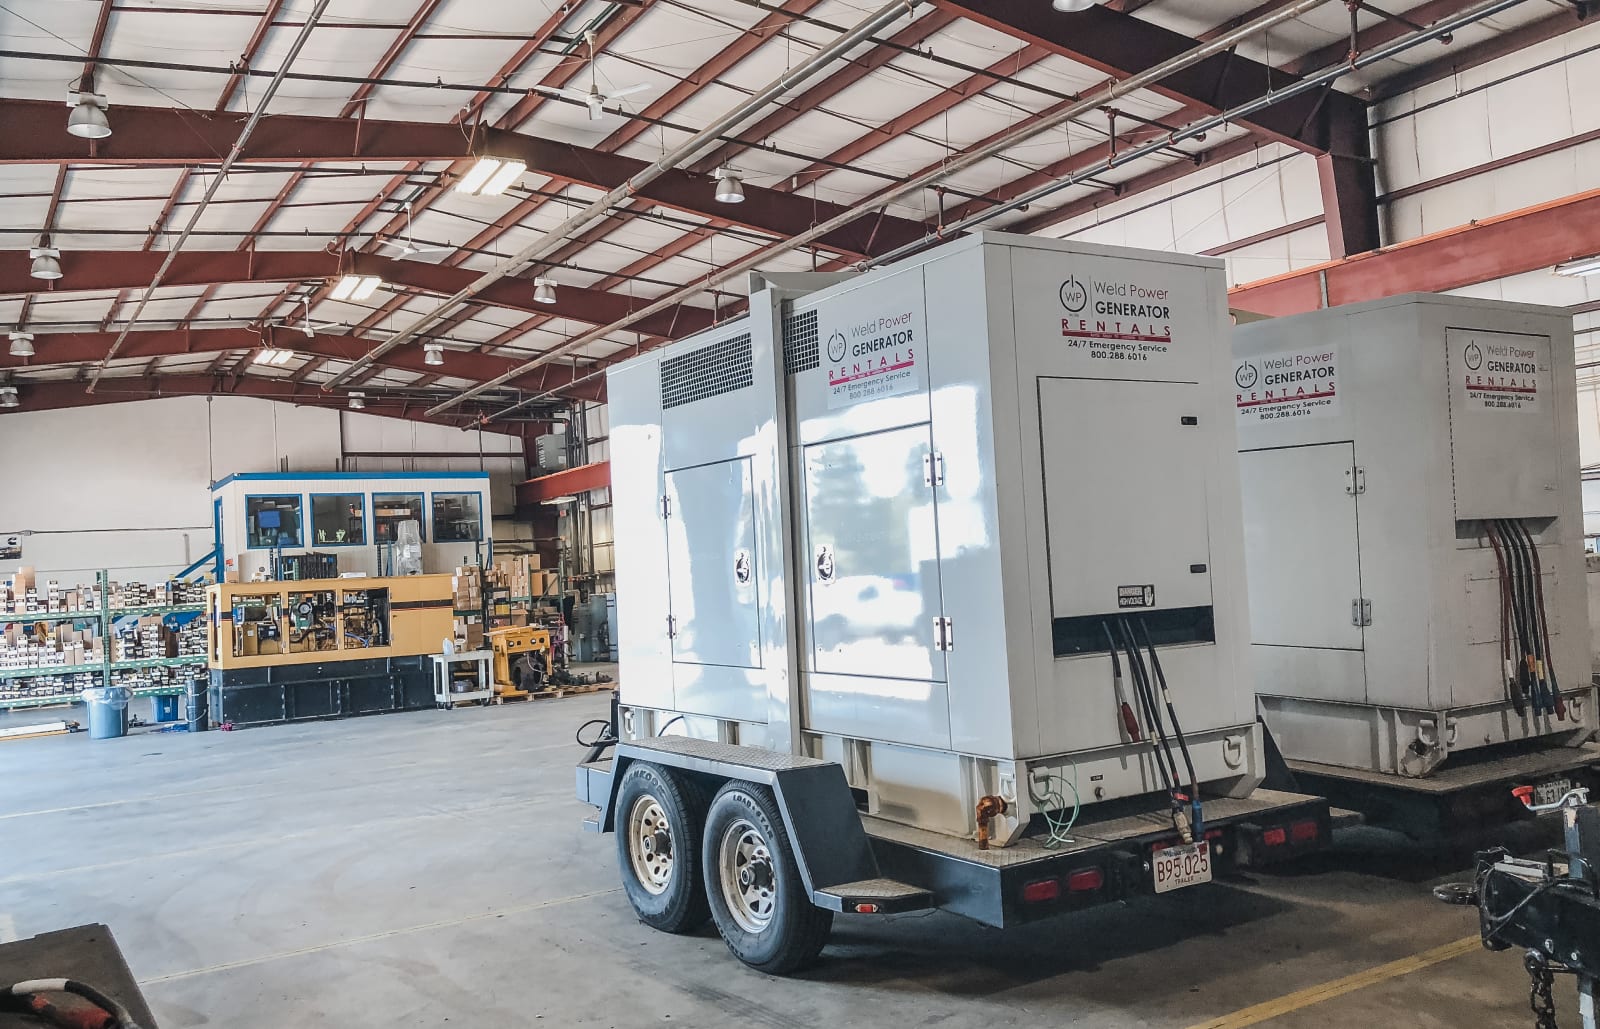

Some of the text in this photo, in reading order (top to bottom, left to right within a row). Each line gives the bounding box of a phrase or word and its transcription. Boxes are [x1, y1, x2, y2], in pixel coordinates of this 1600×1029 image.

[1065, 292, 1082, 303] WP
[1094, 280, 1168, 300] Weld Power
[1096, 301, 1170, 319] GENERATOR
[852, 312, 912, 338] Weld Power
[1062, 318, 1170, 336] RENTALS
[831, 342, 843, 355] WP
[852, 330, 913, 356] GENERATOR
[1068, 340, 1167, 352] 24/7 Emergency Service
[1091, 351, 1147, 360] 800.288.6016
[1487, 345, 1535, 358] Weld Power
[829, 349, 914, 379] RENTALS
[1264, 352, 1334, 369] Weld Power
[1488, 361, 1536, 374] GENERATOR
[833, 386, 847, 395] 24/7
[848, 377, 884, 391] Emergency
[886, 370, 911, 381] Service
[1240, 372, 1254, 381] WP
[1265, 366, 1334, 385] GENERATOR
[1466, 376, 1536, 388] RENTALS
[1236, 382, 1335, 402] RENTALS
[1259, 404, 1300, 413] Emergency
[1303, 400, 1331, 408] Service
[1260, 409, 1311, 420] 800.288.6016
